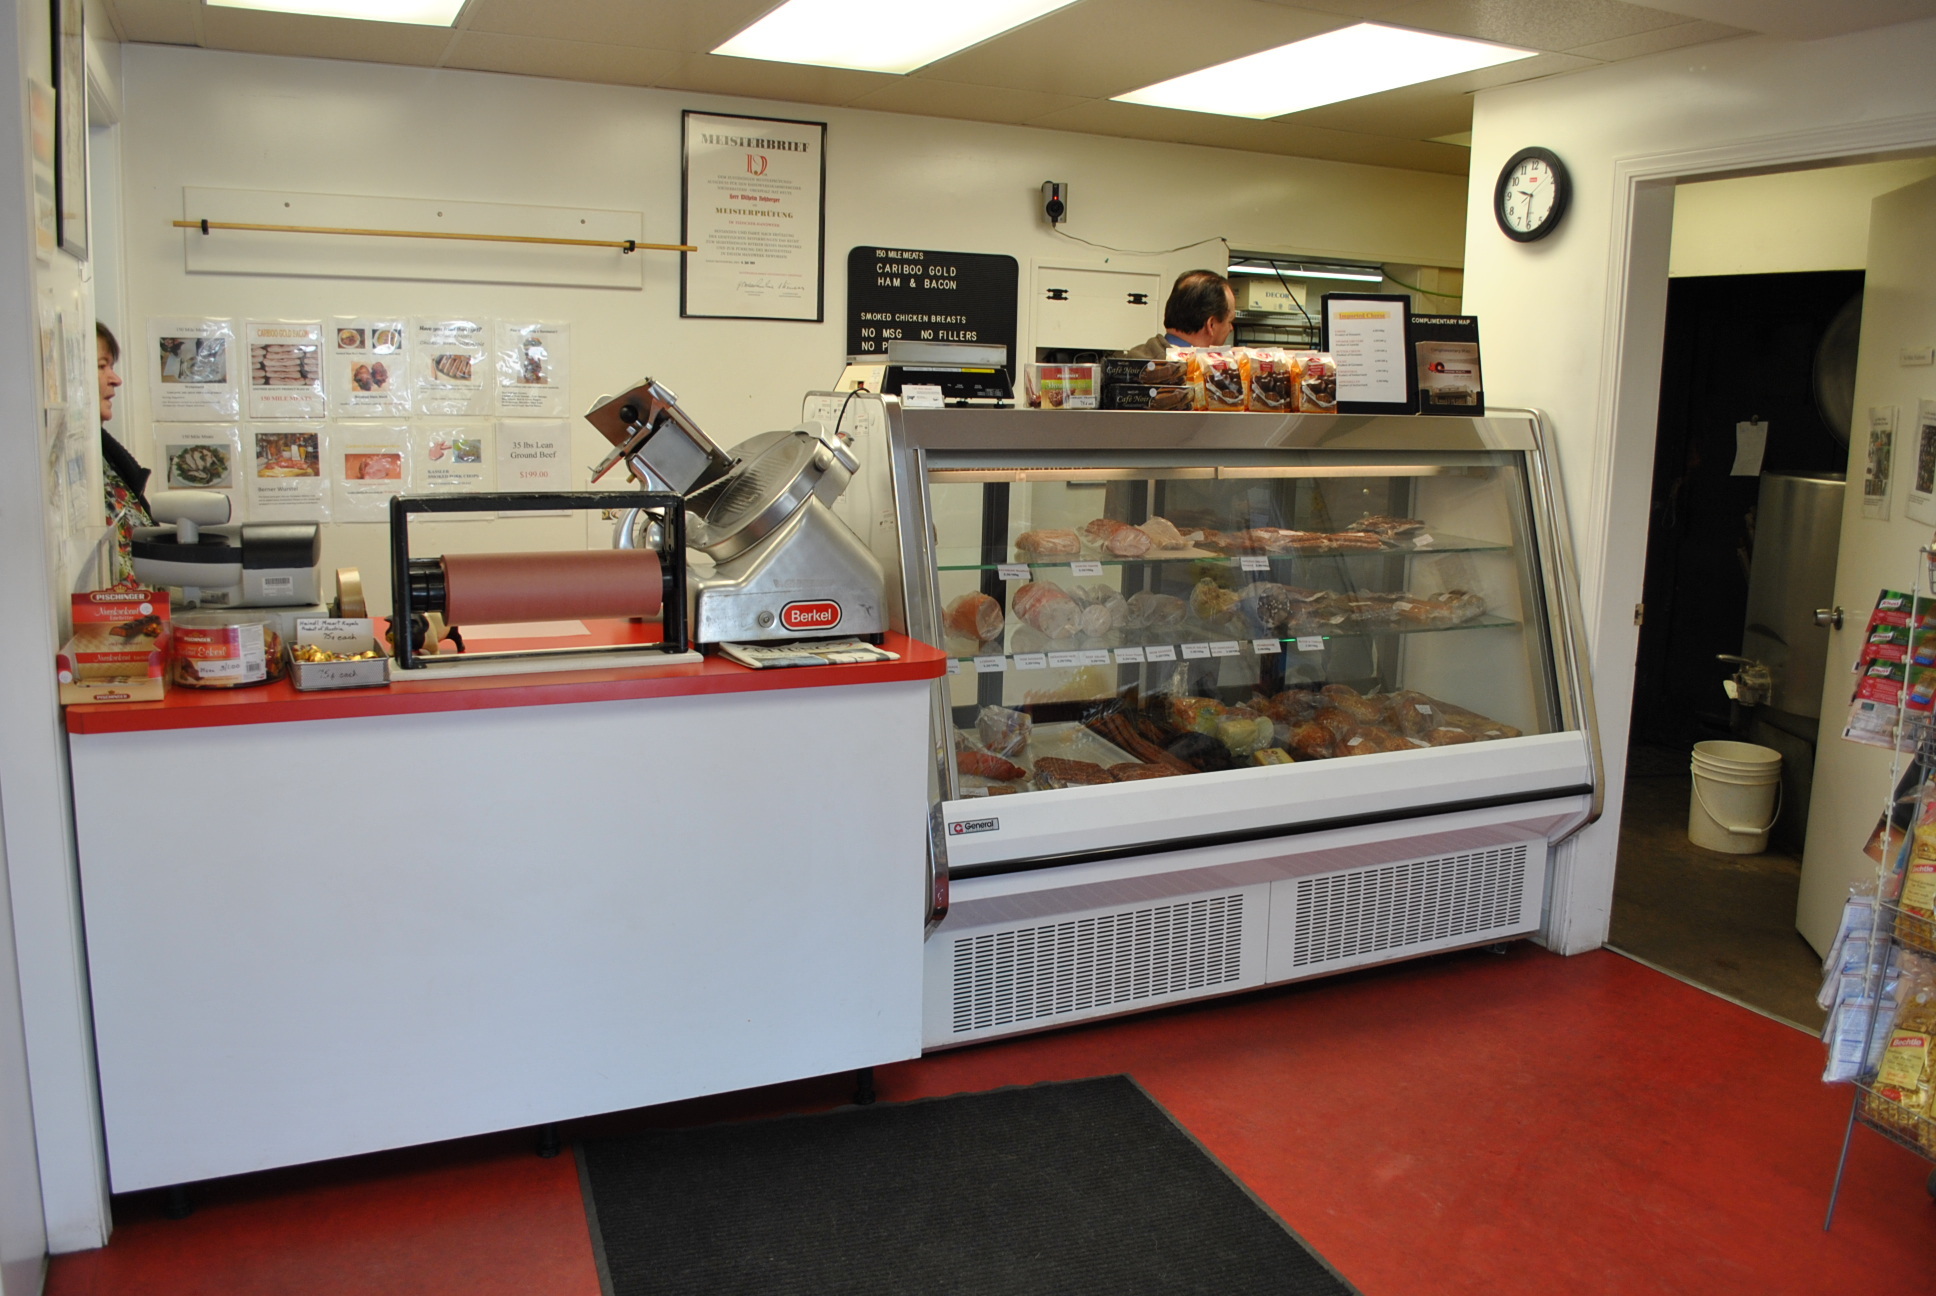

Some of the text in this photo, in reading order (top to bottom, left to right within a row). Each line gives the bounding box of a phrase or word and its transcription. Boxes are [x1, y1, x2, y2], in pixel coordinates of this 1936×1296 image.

[701, 133, 810, 153] MEISTERBRIEF
[1531, 160, 1540, 171] 12
[1506, 191, 1512, 202] 9
[715, 207, 794, 219] MEISTERPRÜFUNG
[1509, 206, 1515, 216] 8
[876, 263, 957, 277] CARIBOO GOLD
[878, 277, 957, 290] HAM & BACON
[860, 312, 966, 324] SMOKED CHICKEN BREASTS
[1411, 317, 1457, 325] COMPLIMENTARY
[861, 328, 977, 341] NO MSG NO FILLERS
[861, 341, 875, 351] NO
[1123, 366, 1141, 374] Noir
[512, 441, 554, 449] 35 lbs Lean
[510, 451, 557, 459] Ground Beef
[519, 470, 549, 479] $199.00
[95, 593, 146, 601] PISCHINGER
[791, 608, 832, 623] Berkel
[337, 633, 357, 641] each
[964, 819, 994, 830] General
[1892, 1038, 1922, 1046] Bechtle
